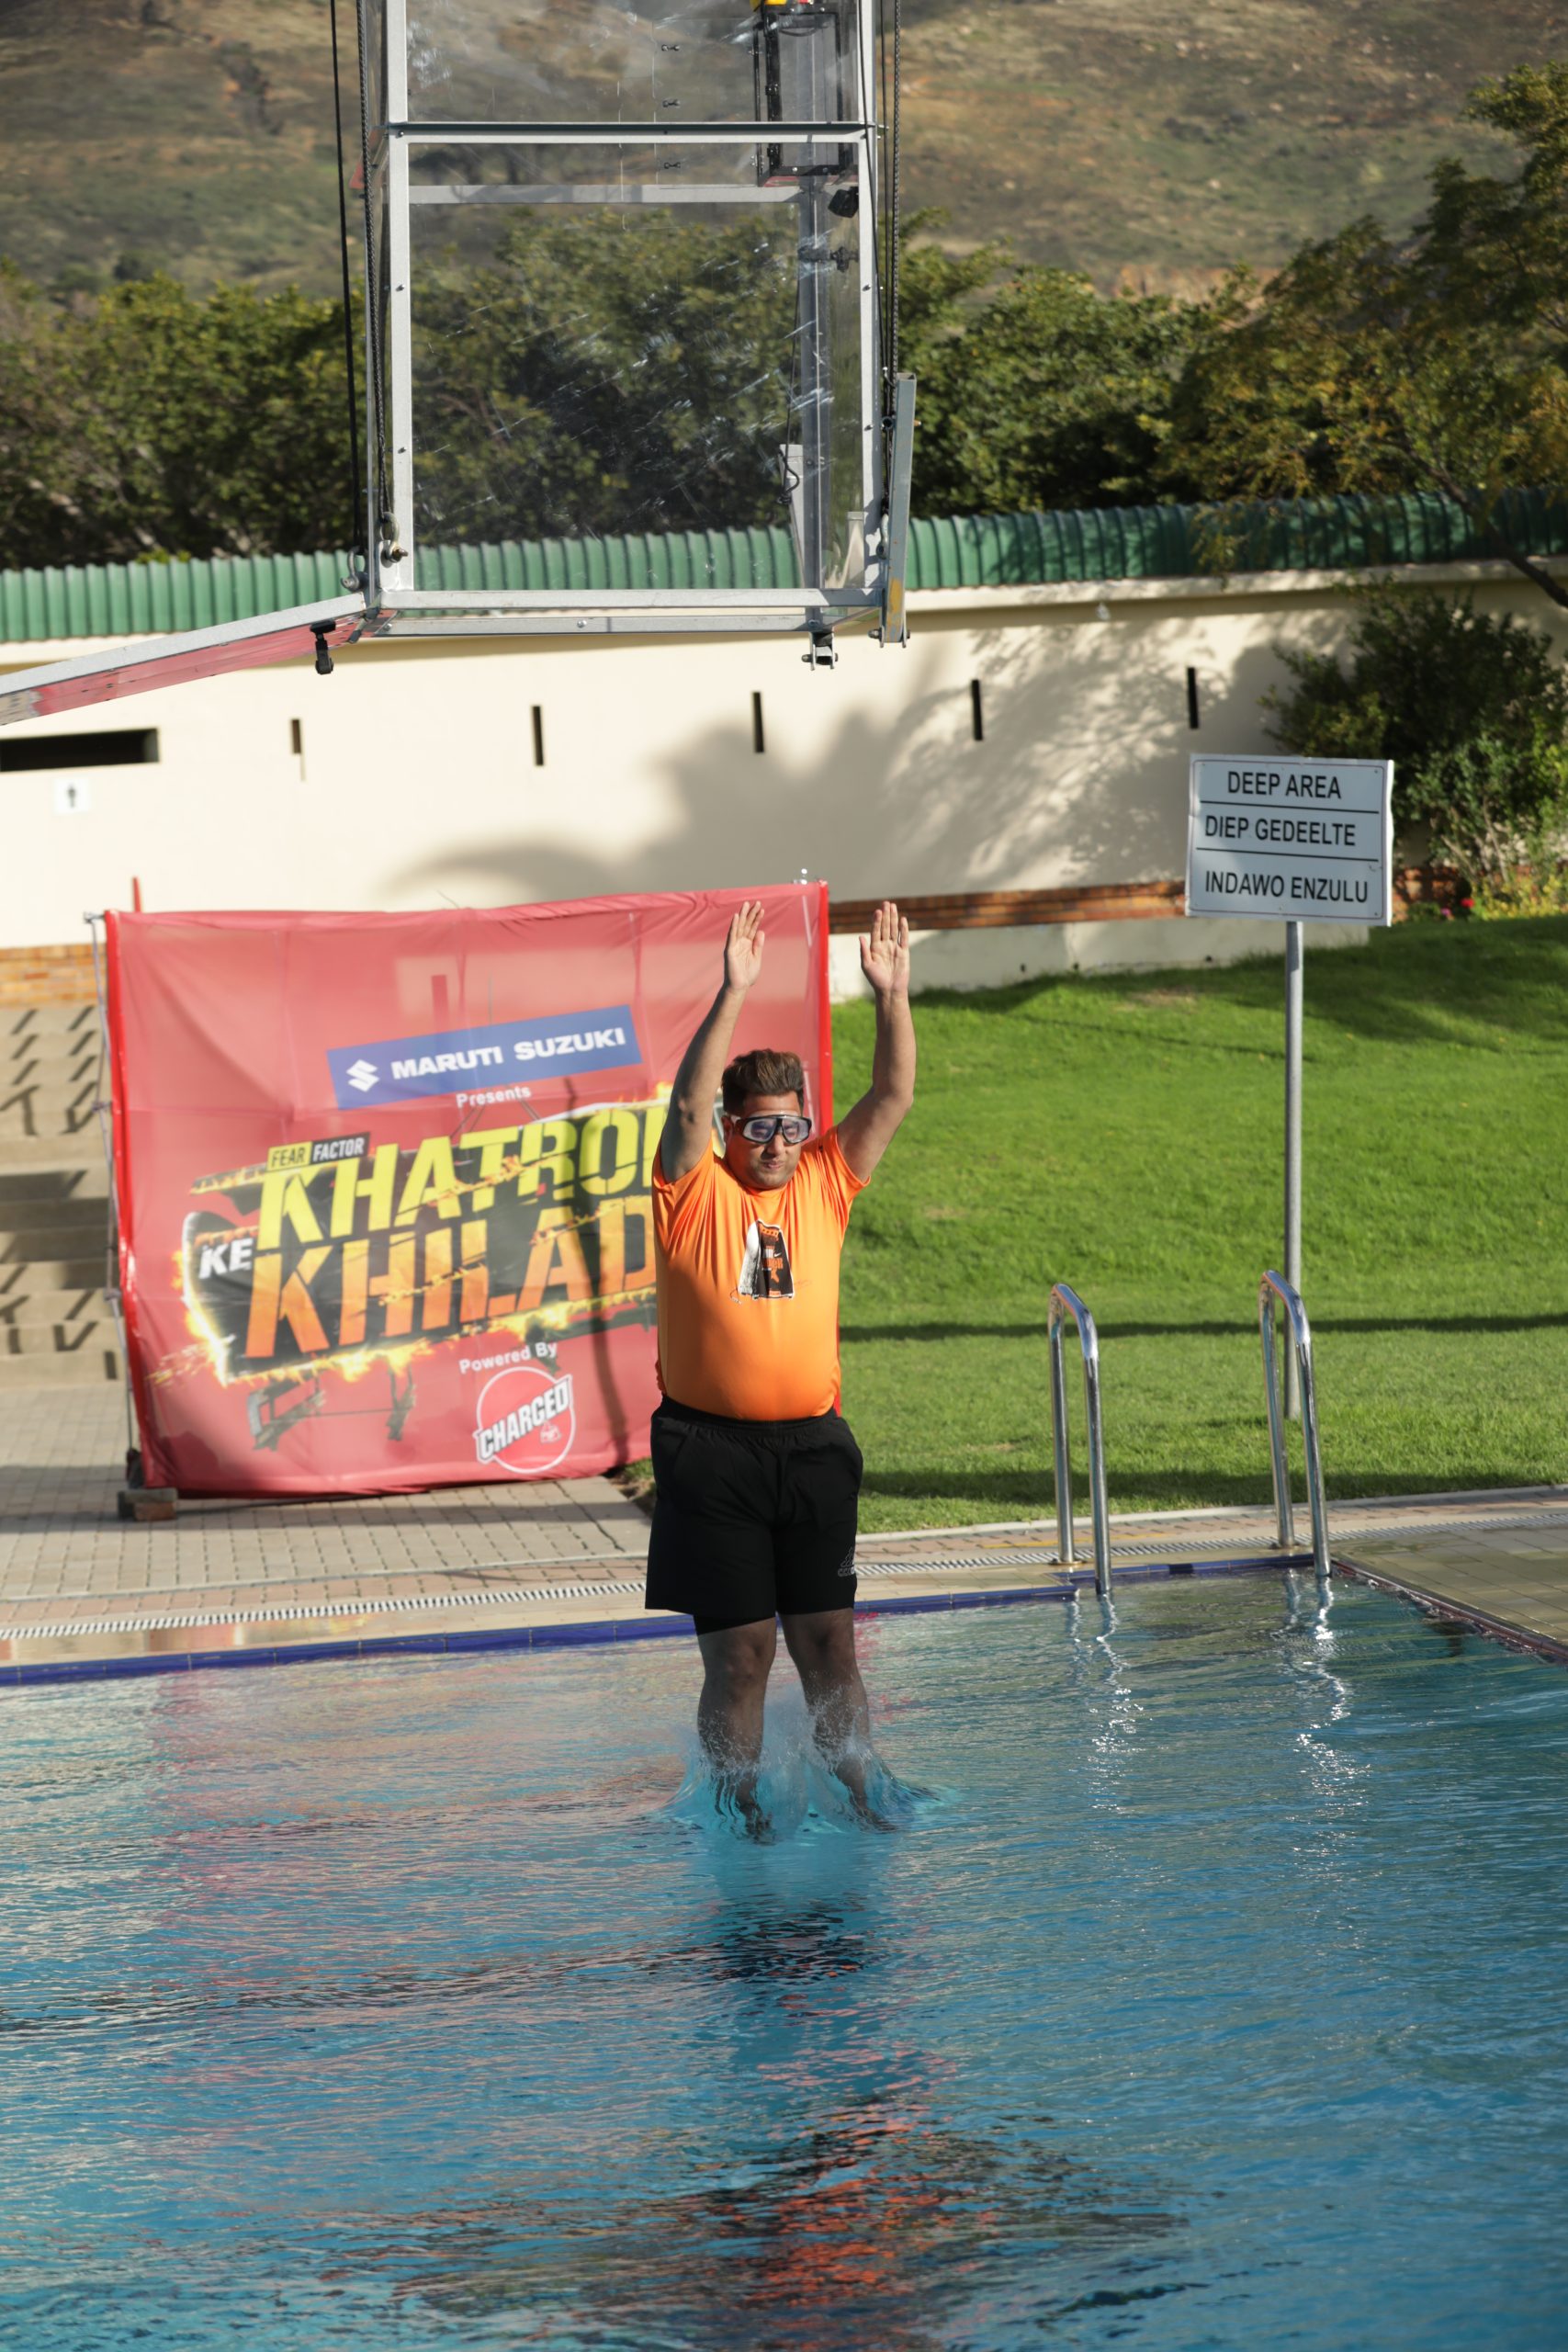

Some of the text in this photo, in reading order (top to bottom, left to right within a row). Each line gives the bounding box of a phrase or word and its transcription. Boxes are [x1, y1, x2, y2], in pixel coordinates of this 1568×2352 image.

[1227, 771, 1342, 799] DEEP AREA
[1205, 815, 1356, 846] DIEP GEDEELTE
[1205, 870, 1369, 903] INDAWO ENZULU
[390, 1027, 626, 1080] MARUTI SUZUKI
[456, 1085, 532, 1108] Presents
[271, 1136, 366, 1168] FEAR FACTOR
[199, 1238, 253, 1280] KE
[459, 1341, 558, 1374] Powered By
[479, 1378, 570, 1460] CHARGED
